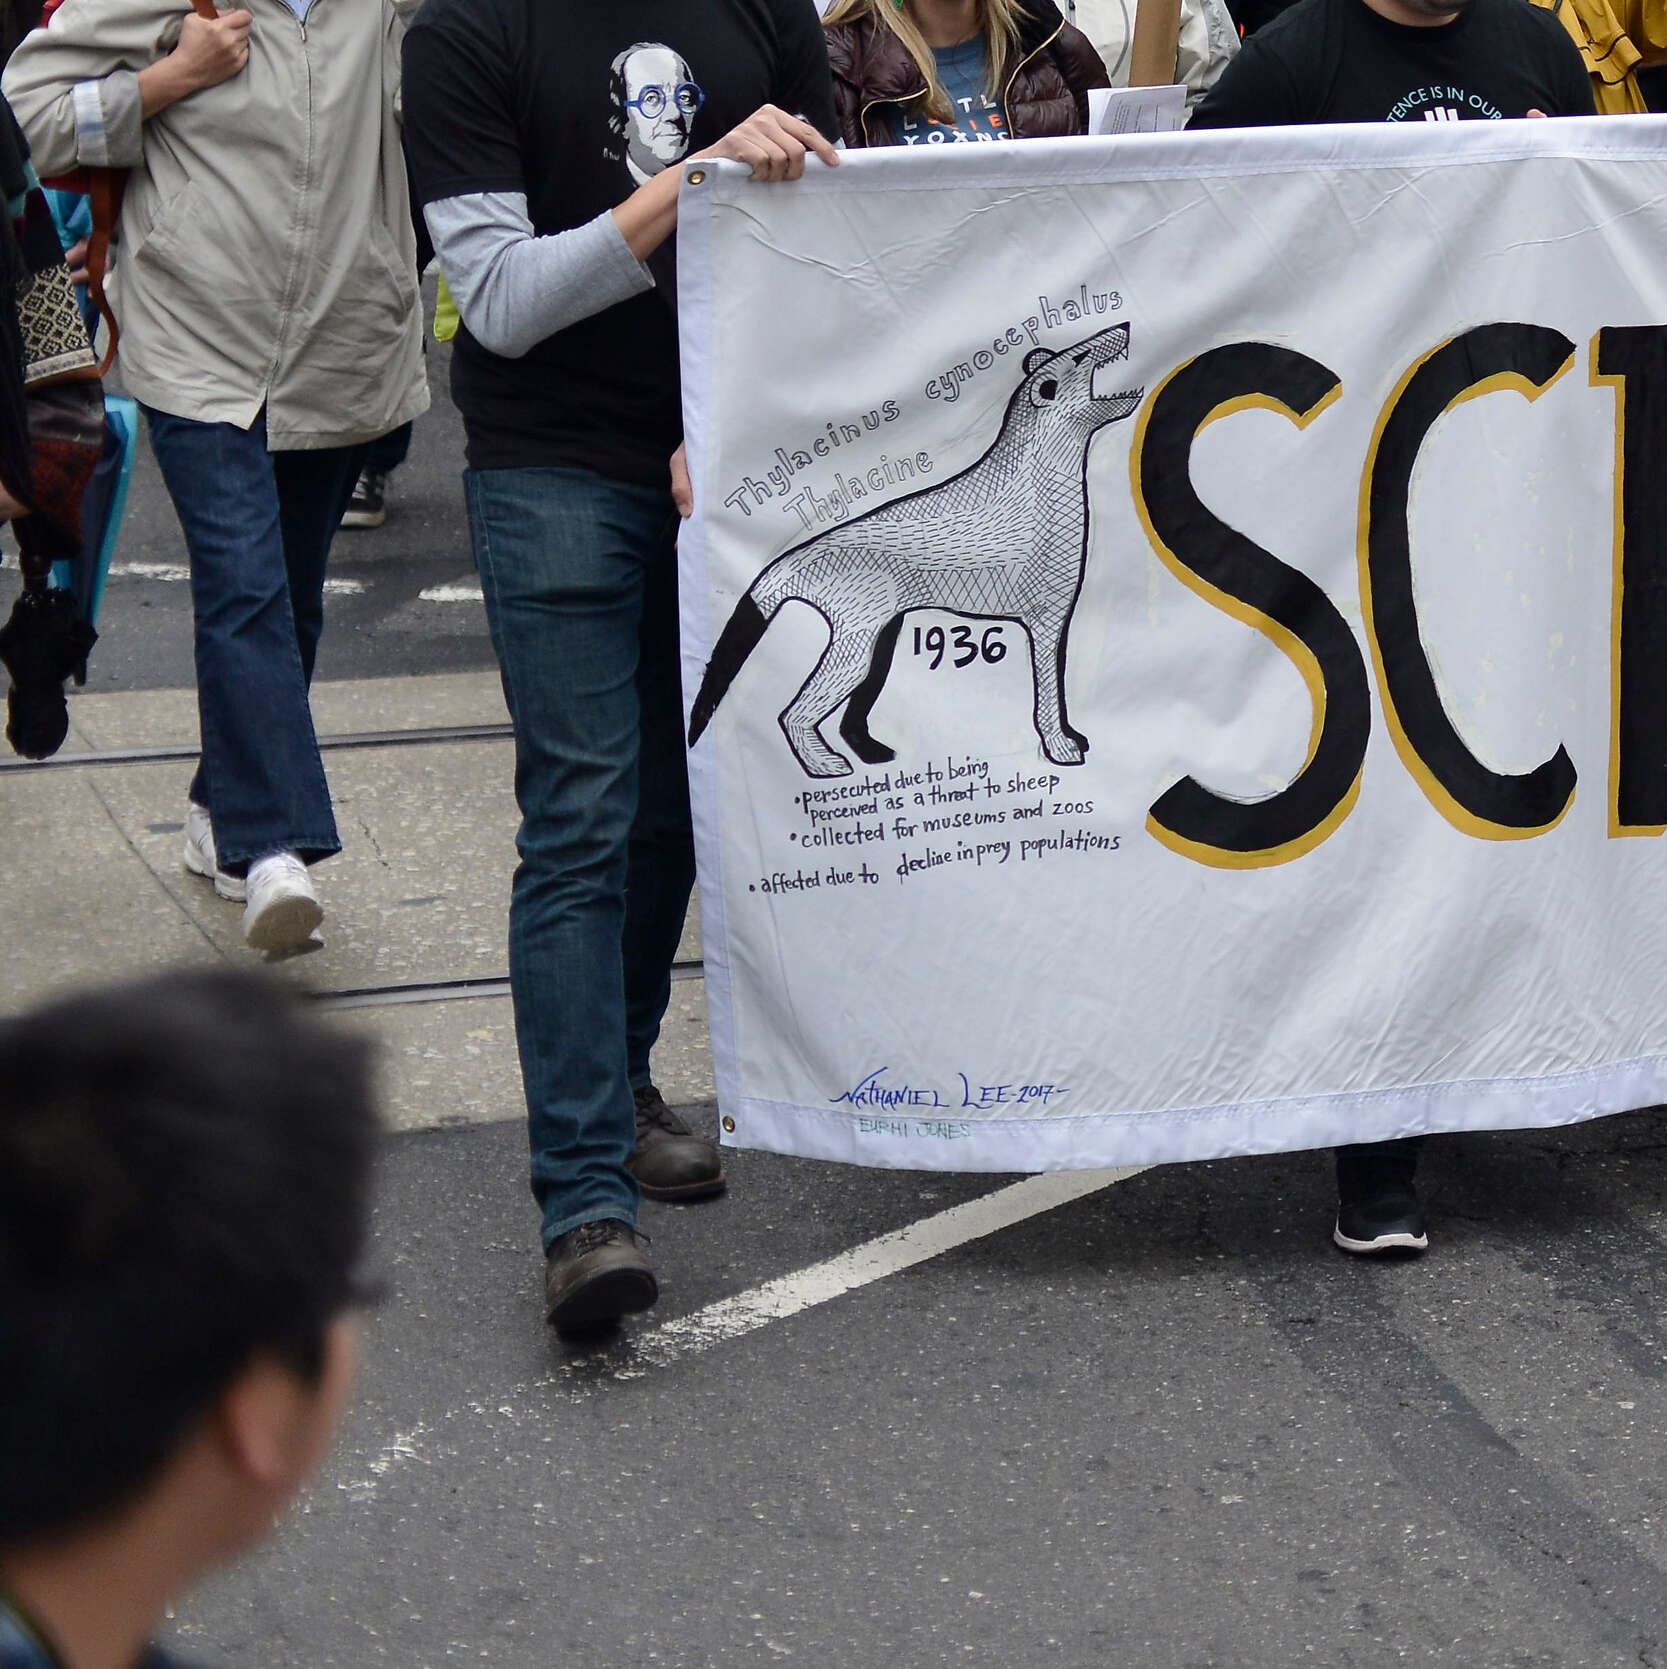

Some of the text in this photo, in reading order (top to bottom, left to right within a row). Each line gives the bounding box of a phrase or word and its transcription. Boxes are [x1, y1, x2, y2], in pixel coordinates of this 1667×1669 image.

[1430, 85, 1443, 100] IS
[1447, 86, 1464, 102] IN
[1468, 94, 1503, 120] OUR
[725, 283, 1124, 518] Thylacinus cynocephalus
[783, 447, 935, 533] Thylacine
[912, 625, 1008, 670] 1936
[802, 756, 989, 814] persecuted due to being
[810, 772, 1060, 828] perceived as a threat to sheep
[801, 799, 1094, 849] collected for museums and zoos
[760, 829, 1122, 894] affected due to decline in prey populations
[829, 1066, 951, 1108] NATHANIEL
[916, 1118, 971, 1140] JONES
